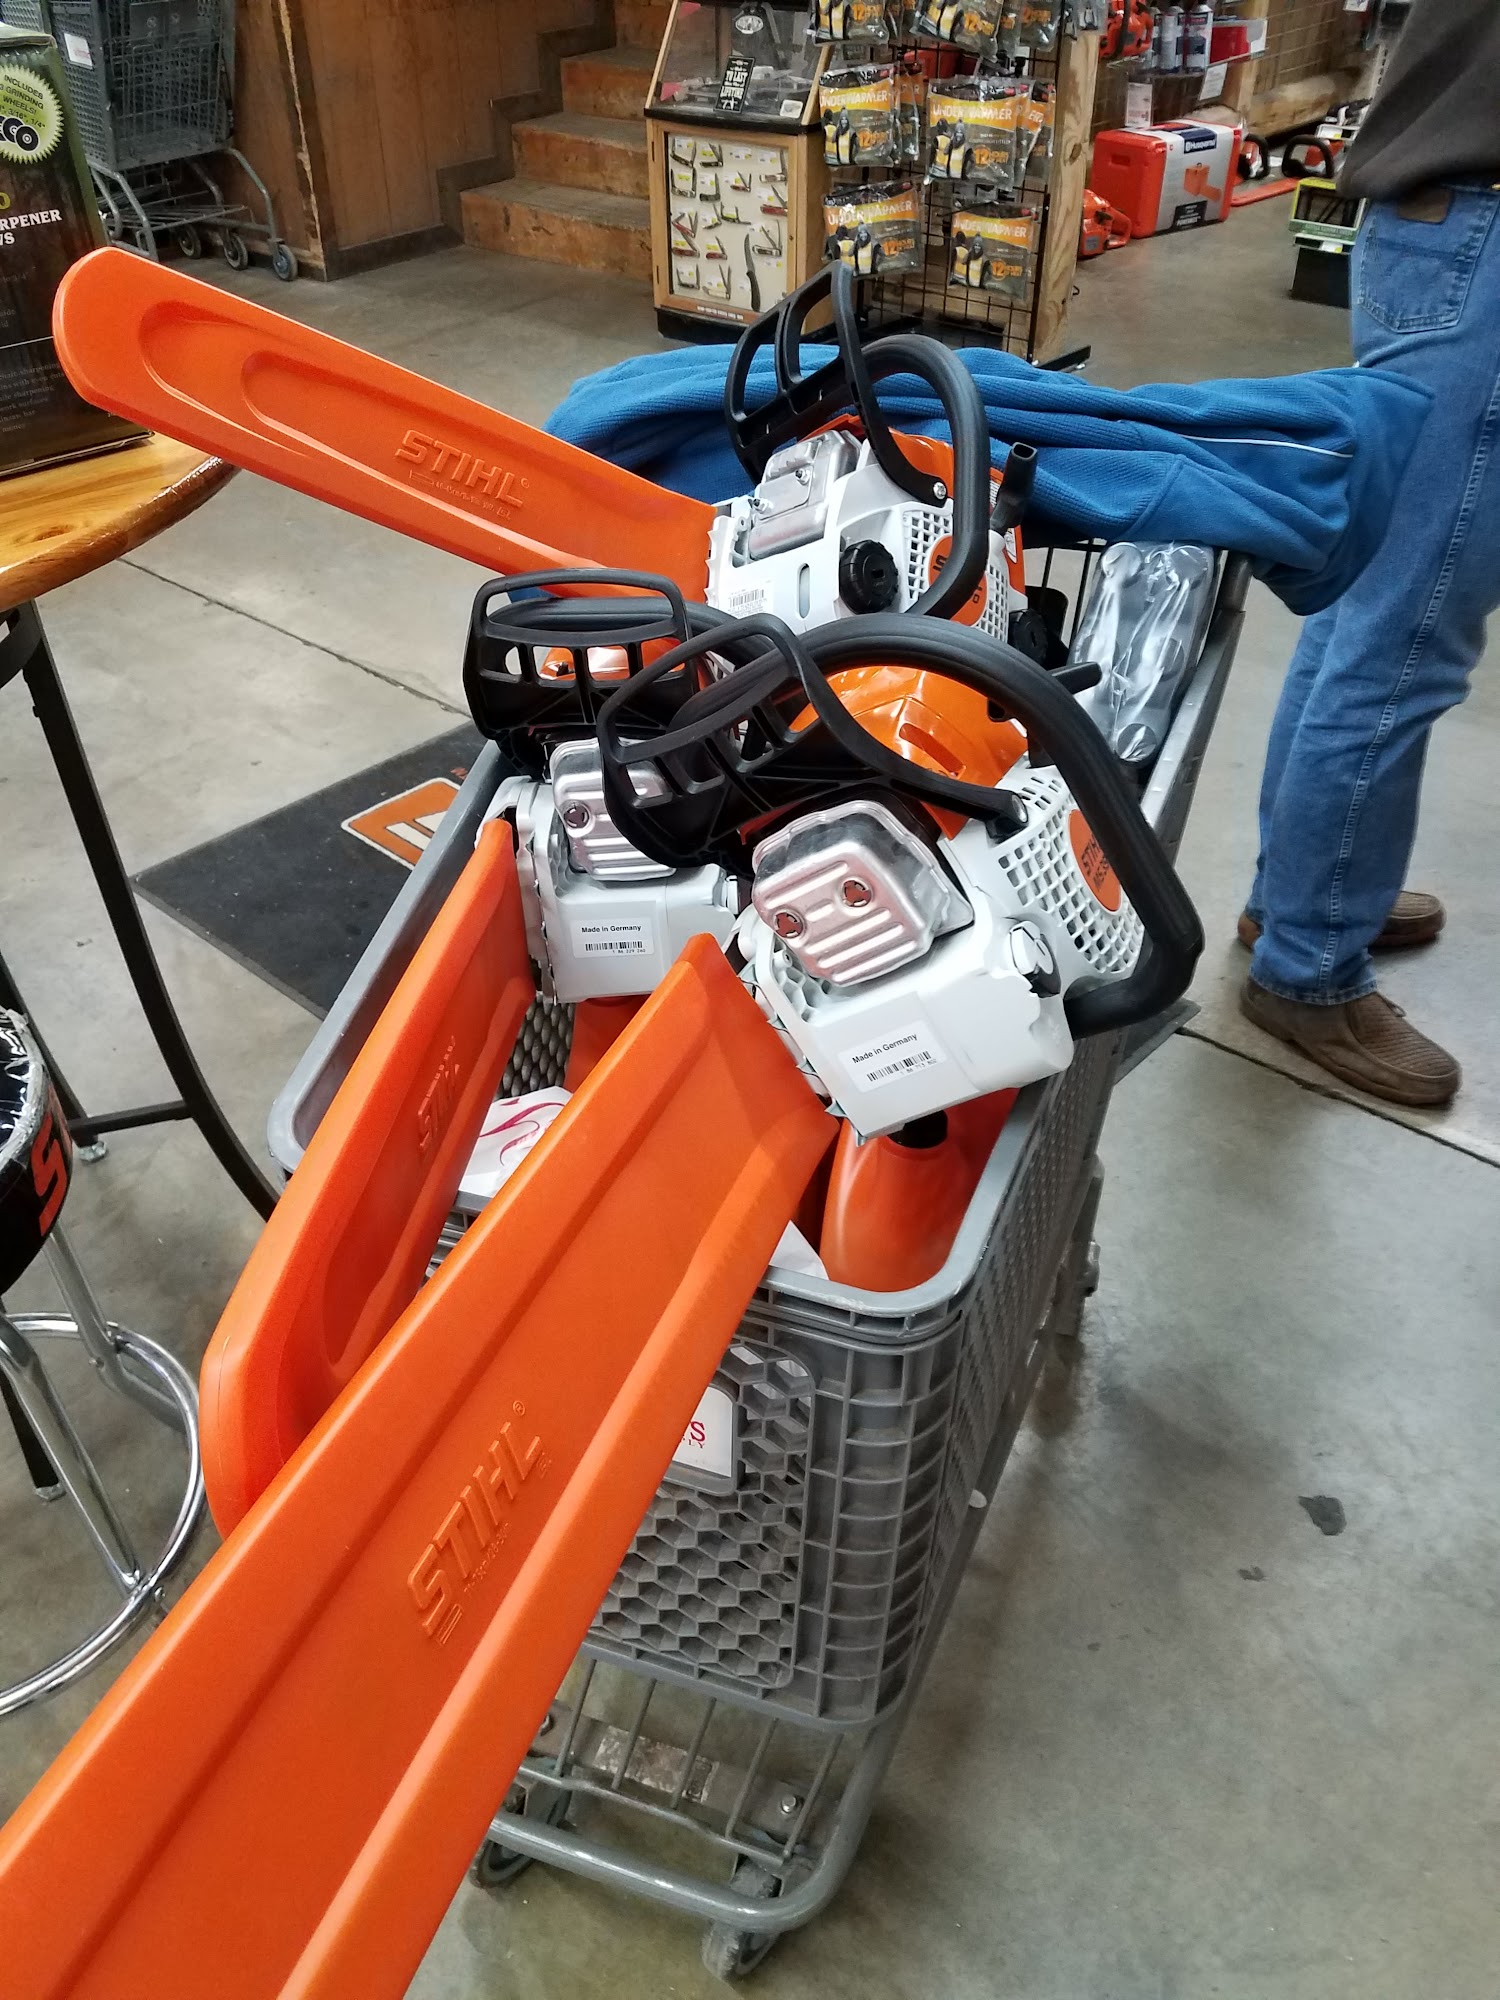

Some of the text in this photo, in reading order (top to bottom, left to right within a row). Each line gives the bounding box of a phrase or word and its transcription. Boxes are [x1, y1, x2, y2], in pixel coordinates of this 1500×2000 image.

[4, 74, 44, 100] INCLUDES
[6, 86, 44, 110] GRINDING
[3, 95, 37, 115] WHEELS!
[394, 429, 524, 509] STIHL
[852, 1033, 918, 1064] Made in Germany
[406, 1420, 542, 1638] STIHL
